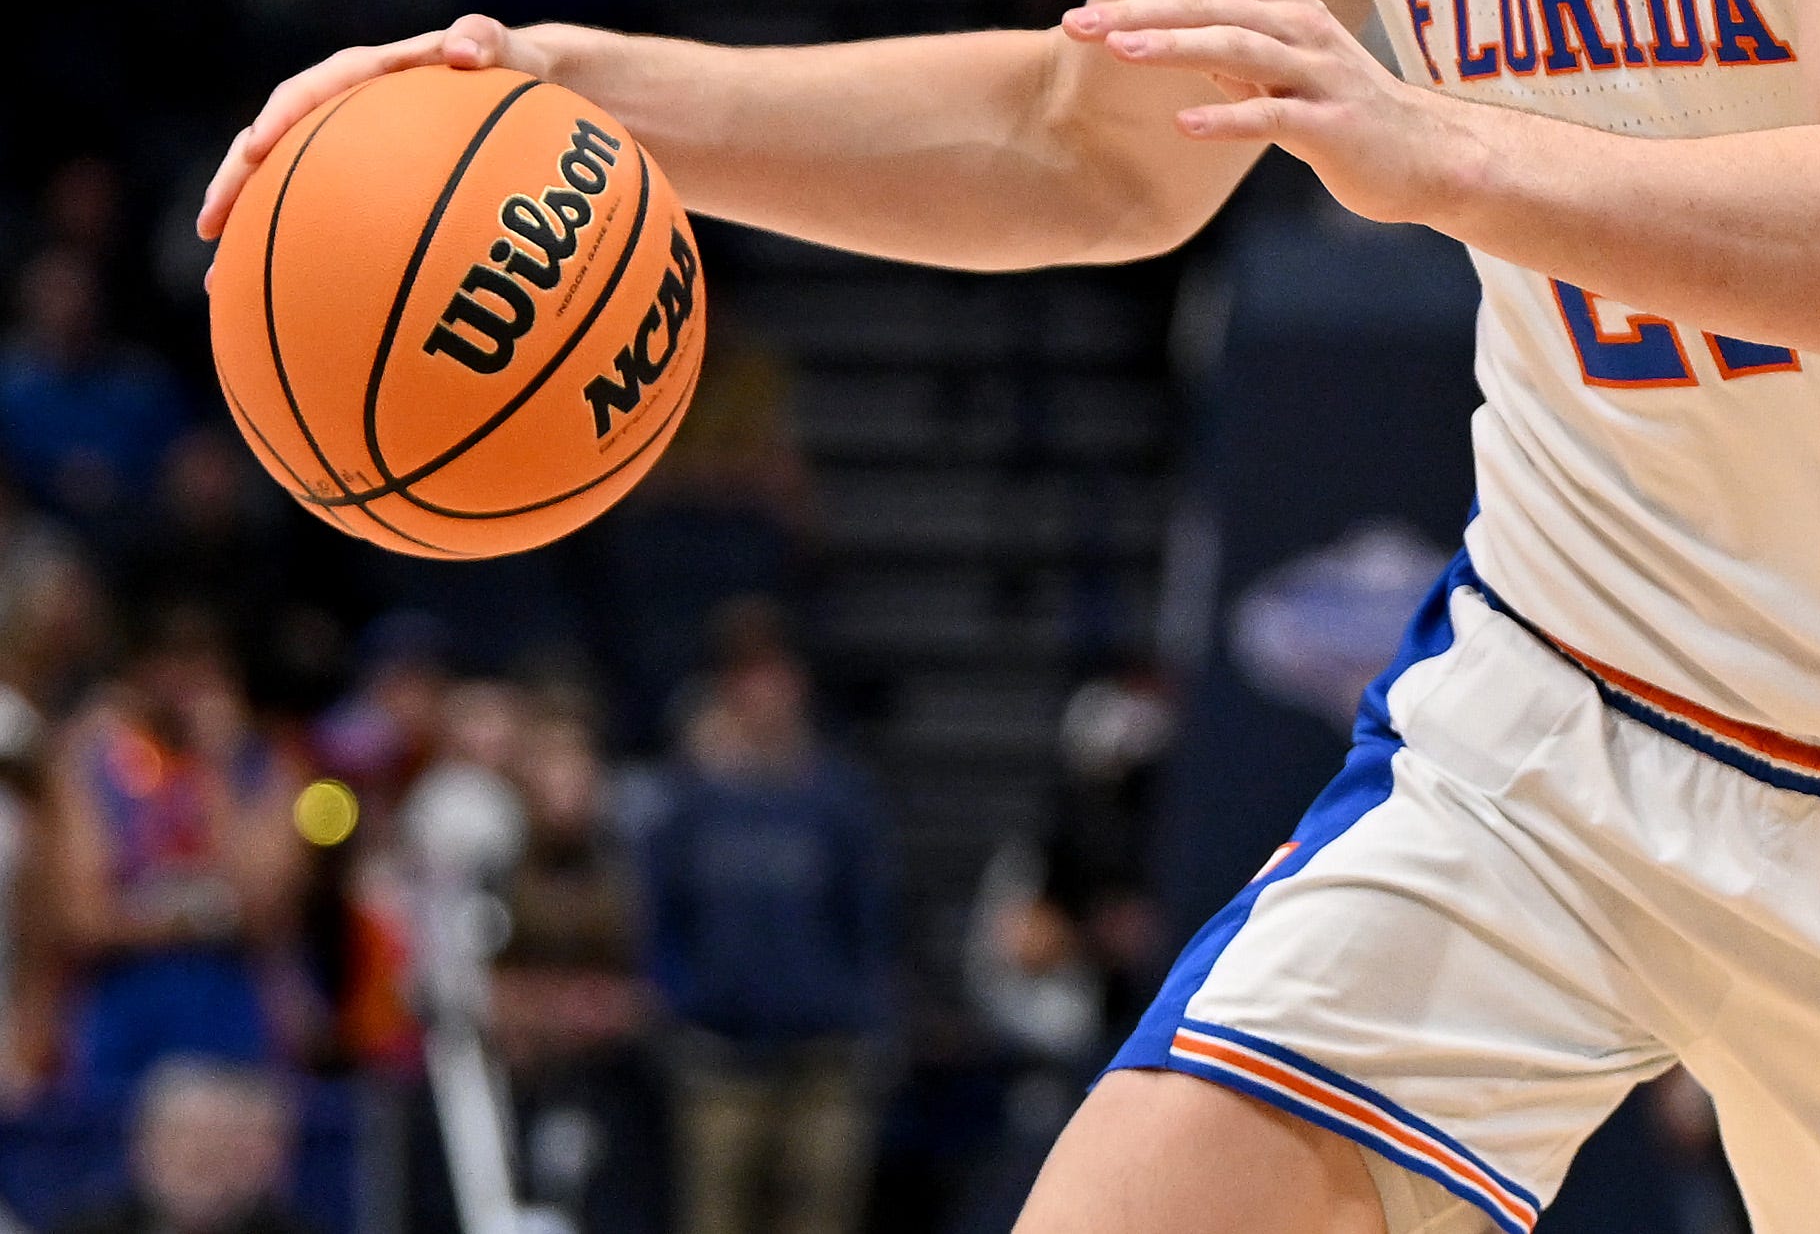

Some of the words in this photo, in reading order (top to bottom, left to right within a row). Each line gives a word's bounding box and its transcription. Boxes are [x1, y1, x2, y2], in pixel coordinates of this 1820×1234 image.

[421, 116, 622, 375] Wilson
[556, 265, 588, 317] INDOOR
[587, 226, 608, 262] GAME
[583, 220, 697, 439] NCAA
